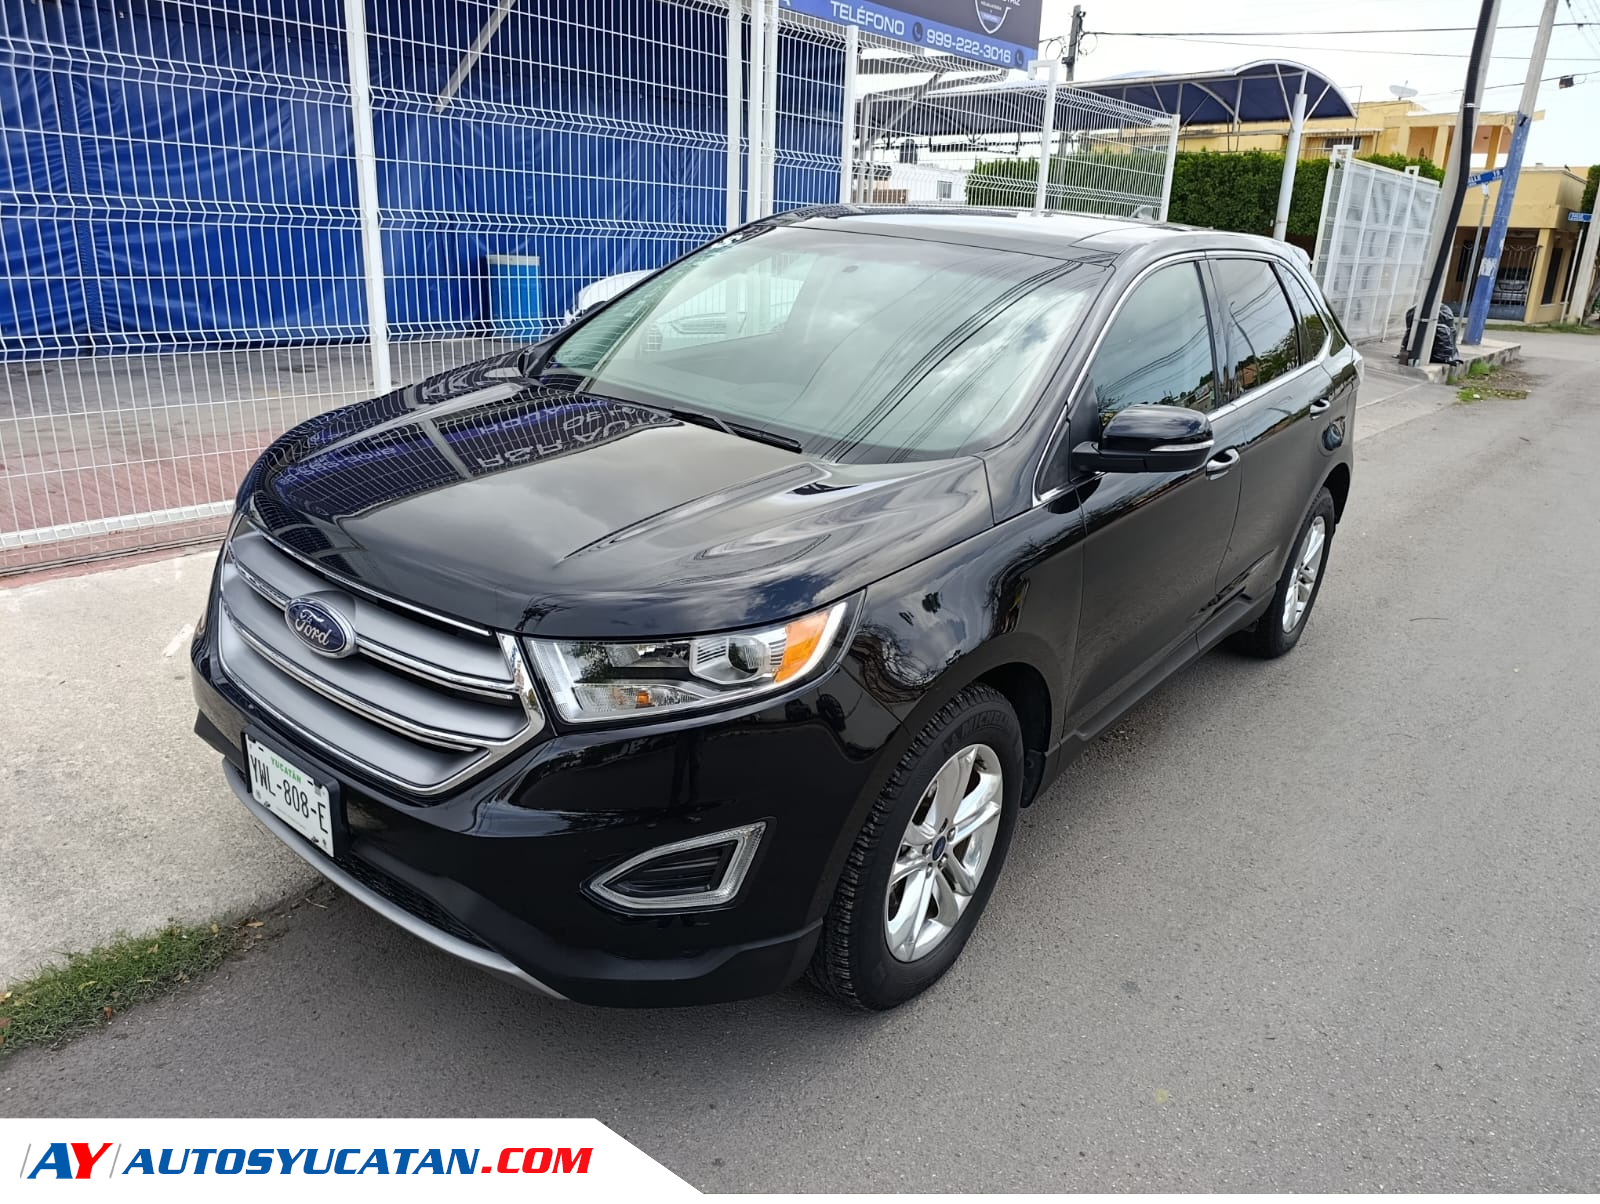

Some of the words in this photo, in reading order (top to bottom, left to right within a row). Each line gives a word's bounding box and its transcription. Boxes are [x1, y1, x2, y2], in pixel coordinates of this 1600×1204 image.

[831, 1, 905, 36] TELÉFONO
[926, 28, 1011, 63] 999-222-3016
[295, 610, 331, 647] Ford
[250, 754, 329, 835] YWL-808-E
